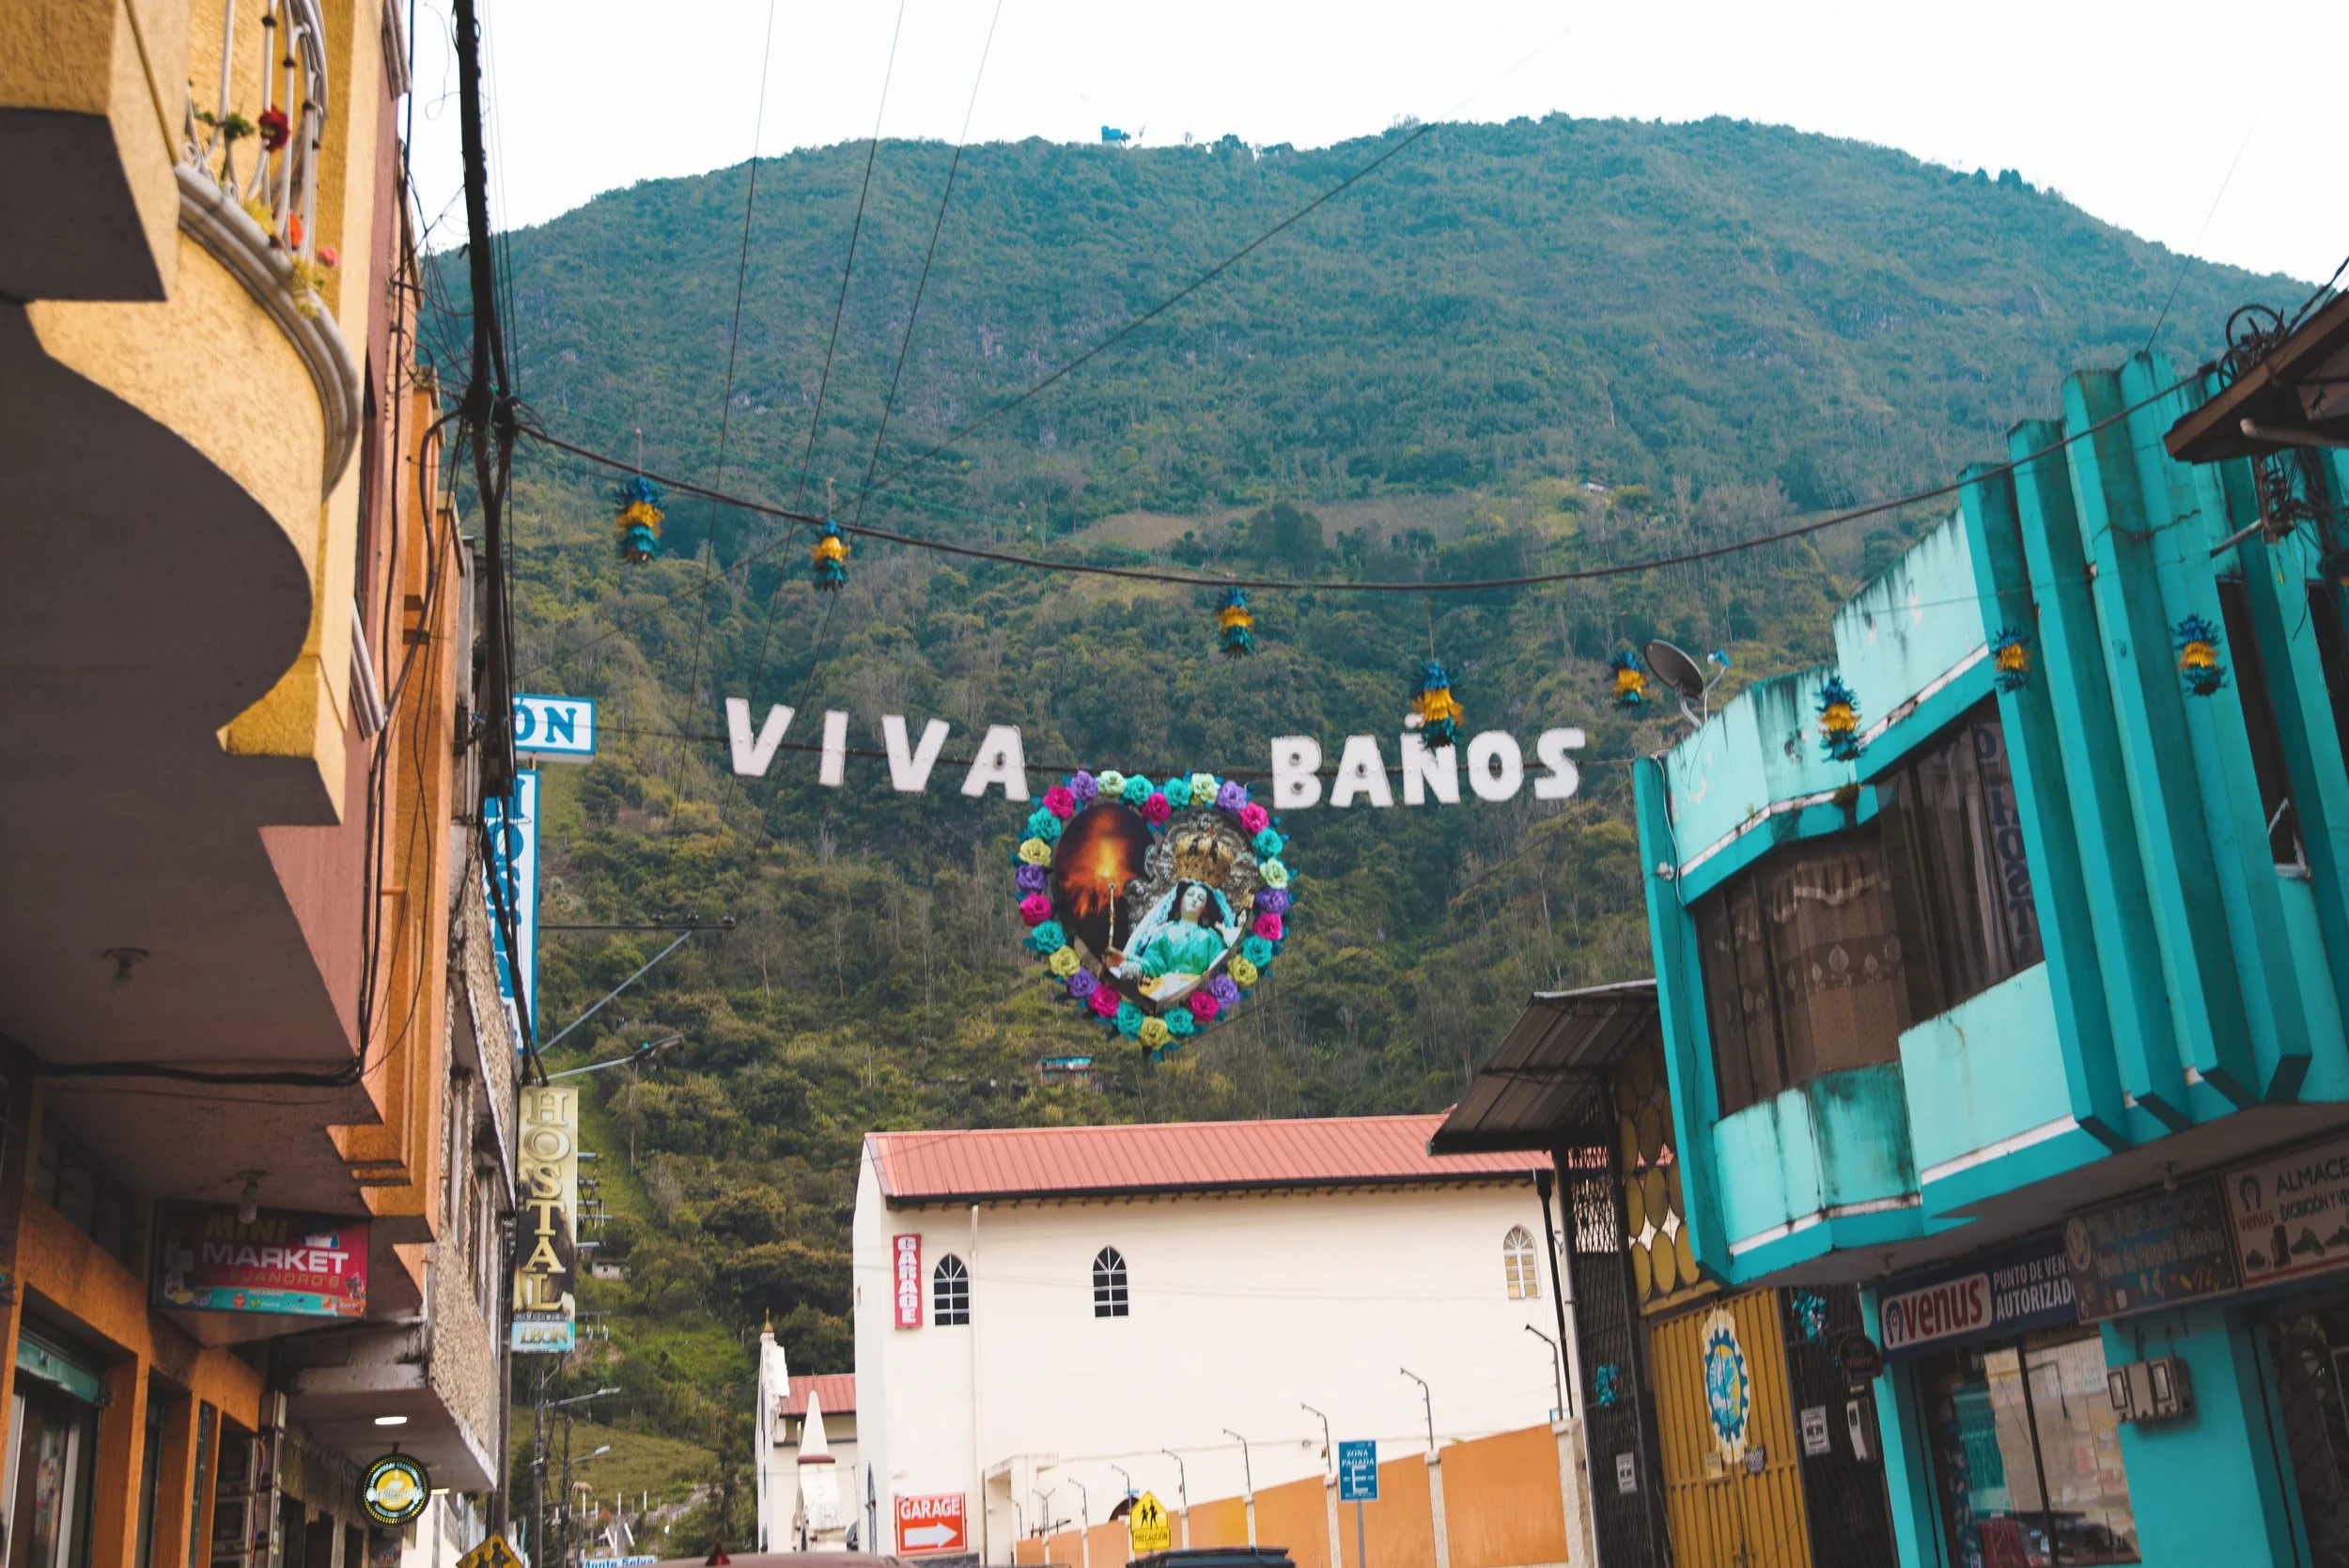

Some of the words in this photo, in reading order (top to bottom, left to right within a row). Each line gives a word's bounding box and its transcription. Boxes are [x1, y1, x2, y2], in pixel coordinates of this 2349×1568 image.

[725, 697, 1030, 802] VIVA
[522, 1089, 570, 1312] HOSTAL
[204, 1213, 290, 1245] MINI
[2239, 1209, 2275, 1232] venus
[202, 1241, 350, 1275] MARKET
[898, 1236, 917, 1325] GARAGE
[1993, 1265, 2028, 1291] PUNTO
[2030, 1261, 2042, 1281] DE
[1902, 1280, 1984, 1340] venus
[1997, 1277, 2076, 1320] AUTORIZAD
[1346, 1449, 1368, 1457] ZONA
[1351, 1466, 1368, 1494] E
[899, 1497, 961, 1520] GARAGE
